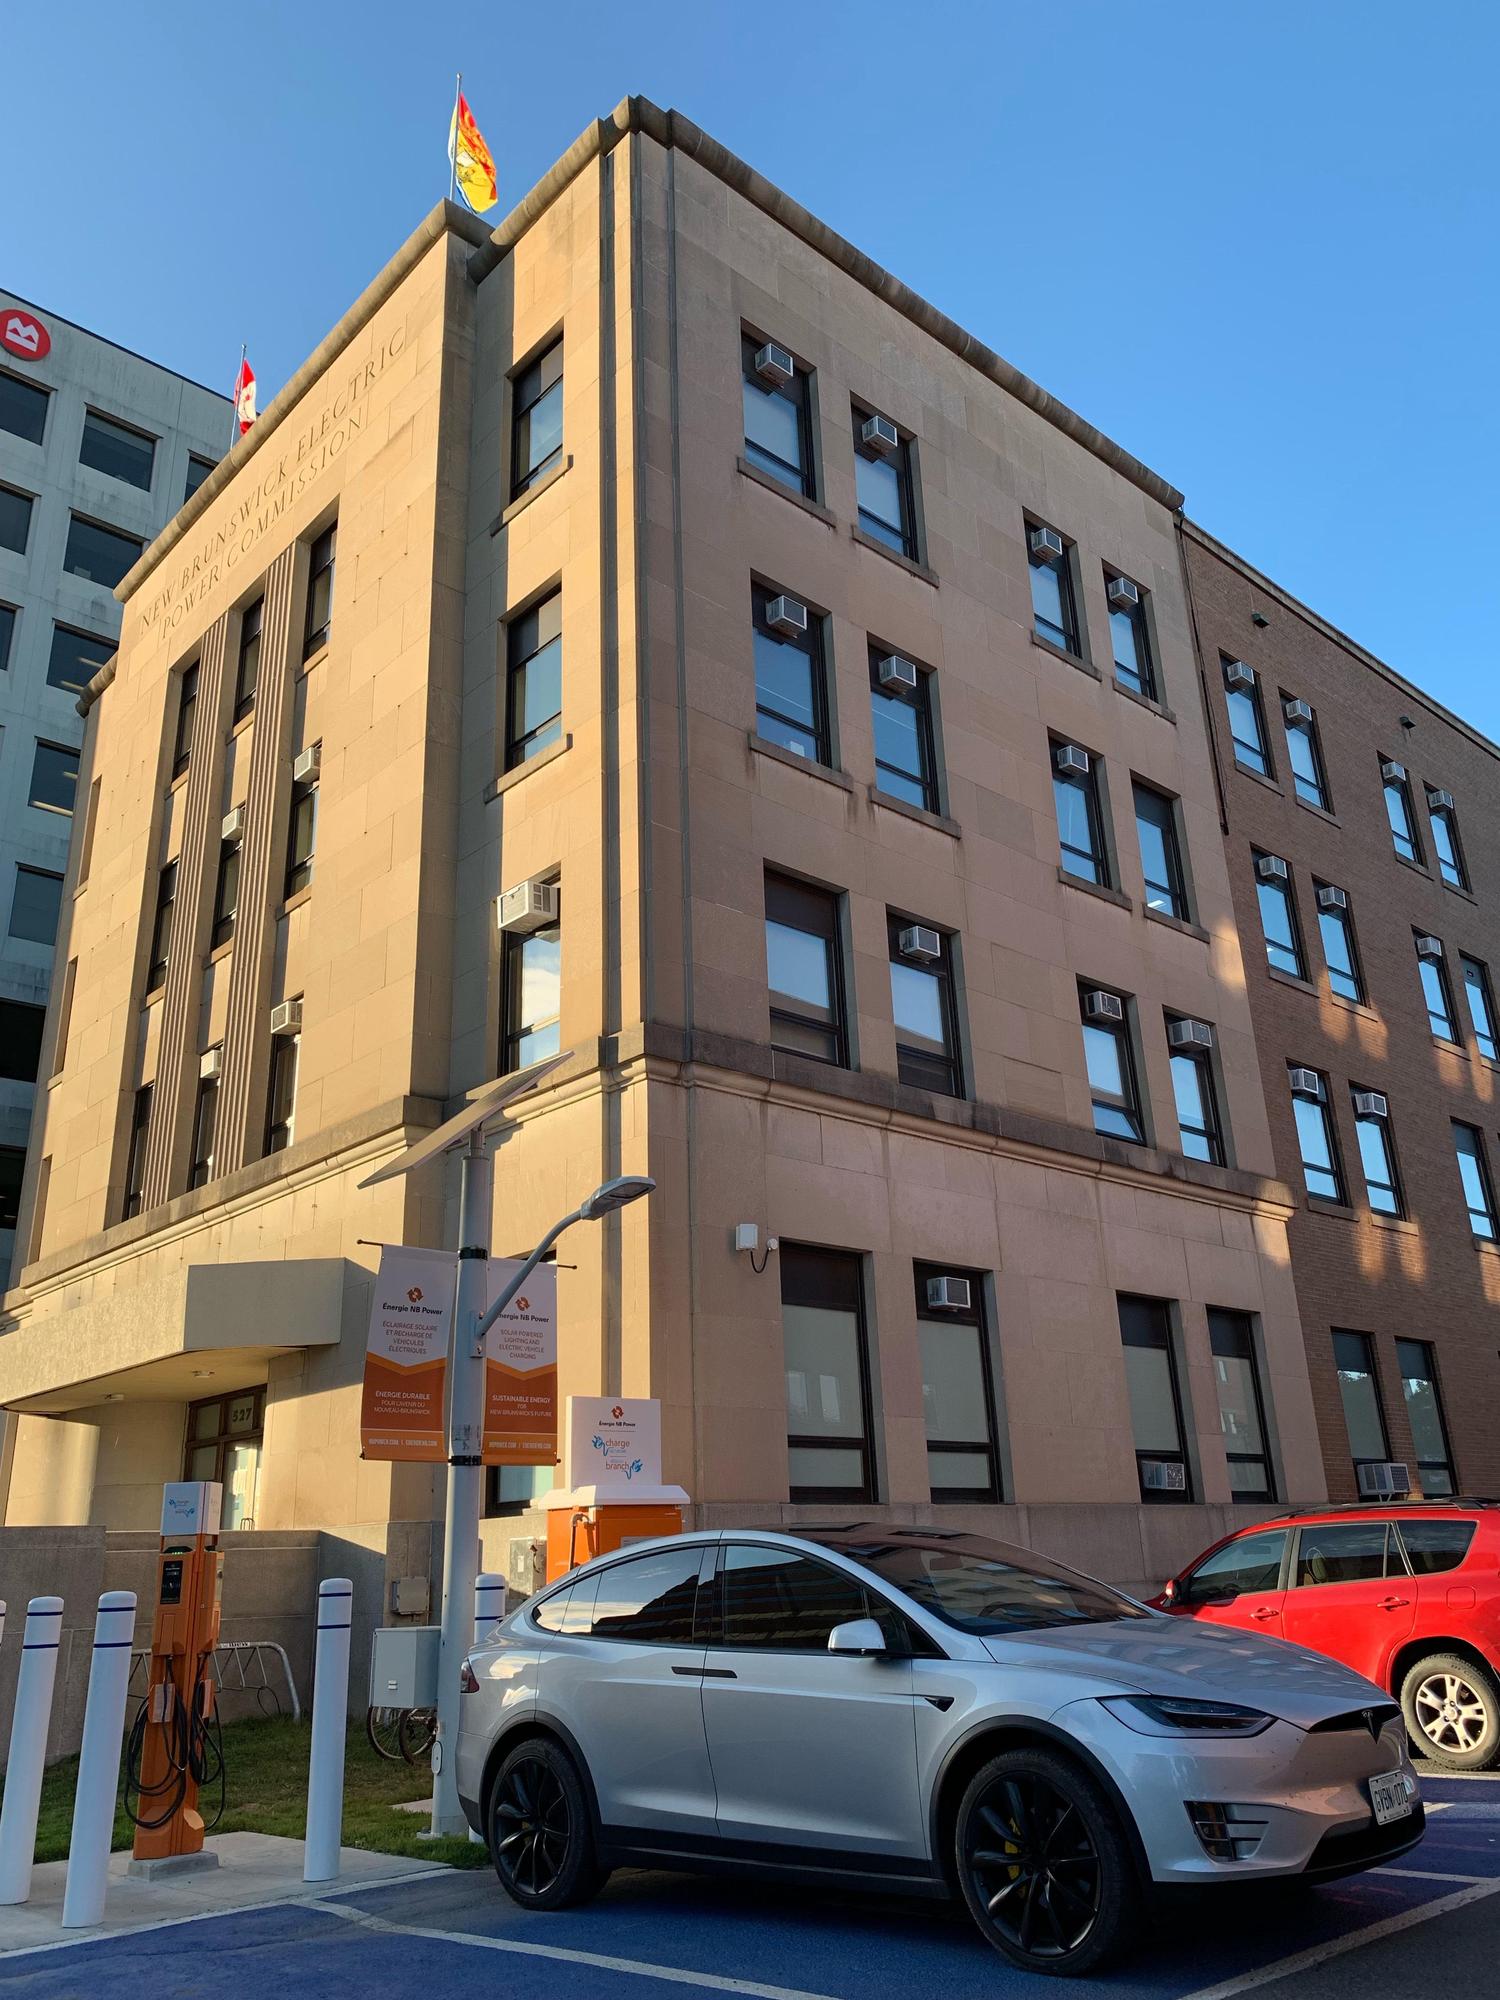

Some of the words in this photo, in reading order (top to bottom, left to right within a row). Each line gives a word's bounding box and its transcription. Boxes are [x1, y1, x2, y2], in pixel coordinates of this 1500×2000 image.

[141, 587, 176, 636] NEW
[181, 454, 289, 591] BRUNSWICK
[296, 326, 405, 463] ELECTRIC
[160, 569, 220, 640] POWER
[226, 405, 363, 570] COMMISSION
[382, 1303, 408, 1312] Énergie
[422, 1306, 443, 1315] Power
[497, 1313, 519, 1321] nergie
[531, 1315, 549, 1323] Power
[519, 1330, 543, 1338] POWERED
[402, 1392, 430, 1400] DURABLE
[233, 1408, 252, 1422] 527
